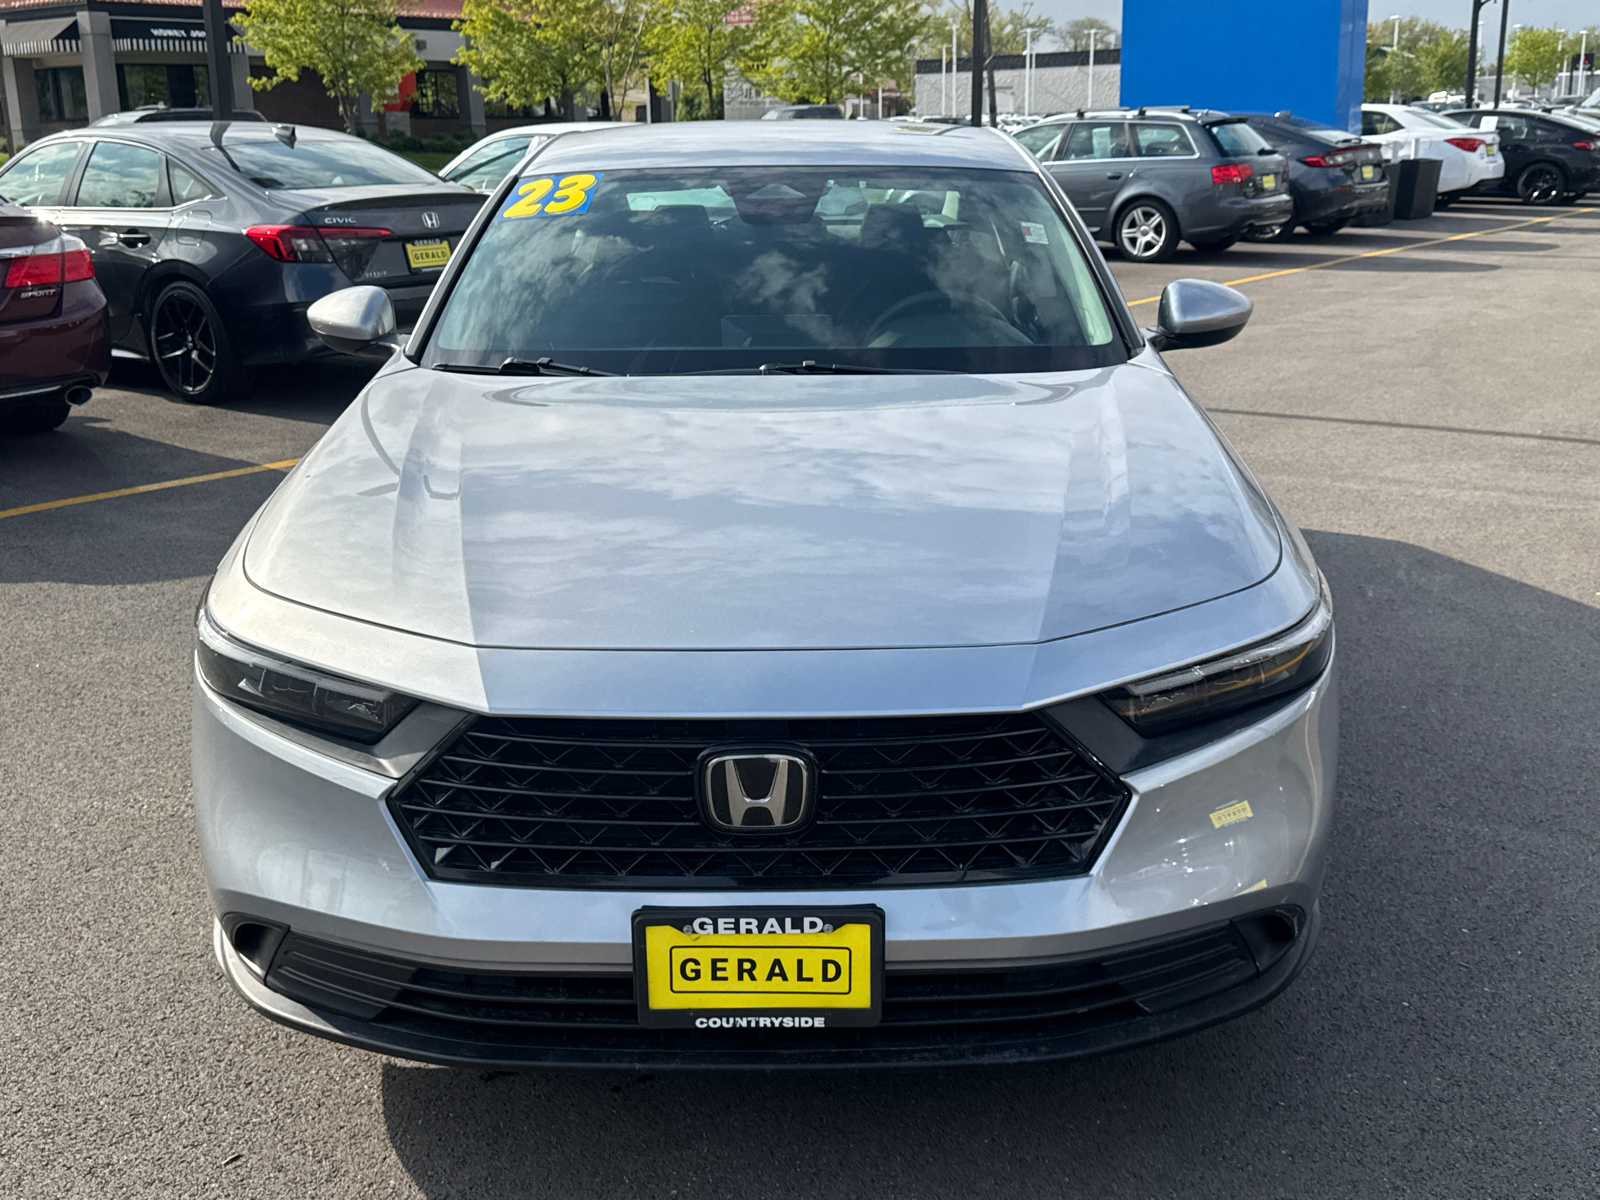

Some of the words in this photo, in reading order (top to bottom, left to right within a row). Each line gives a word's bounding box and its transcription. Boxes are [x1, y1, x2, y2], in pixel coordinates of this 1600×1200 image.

[502, 174, 598, 219] 23
[324, 216, 357, 225] CIVIC
[414, 239, 441, 247] GERALD
[414, 250, 447, 261] GERALD
[20, 288, 56, 299] SPORT
[692, 916, 824, 935] GERALD
[679, 957, 842, 983] GERALD
[695, 1016, 826, 1028] COUNTRYSIDE
